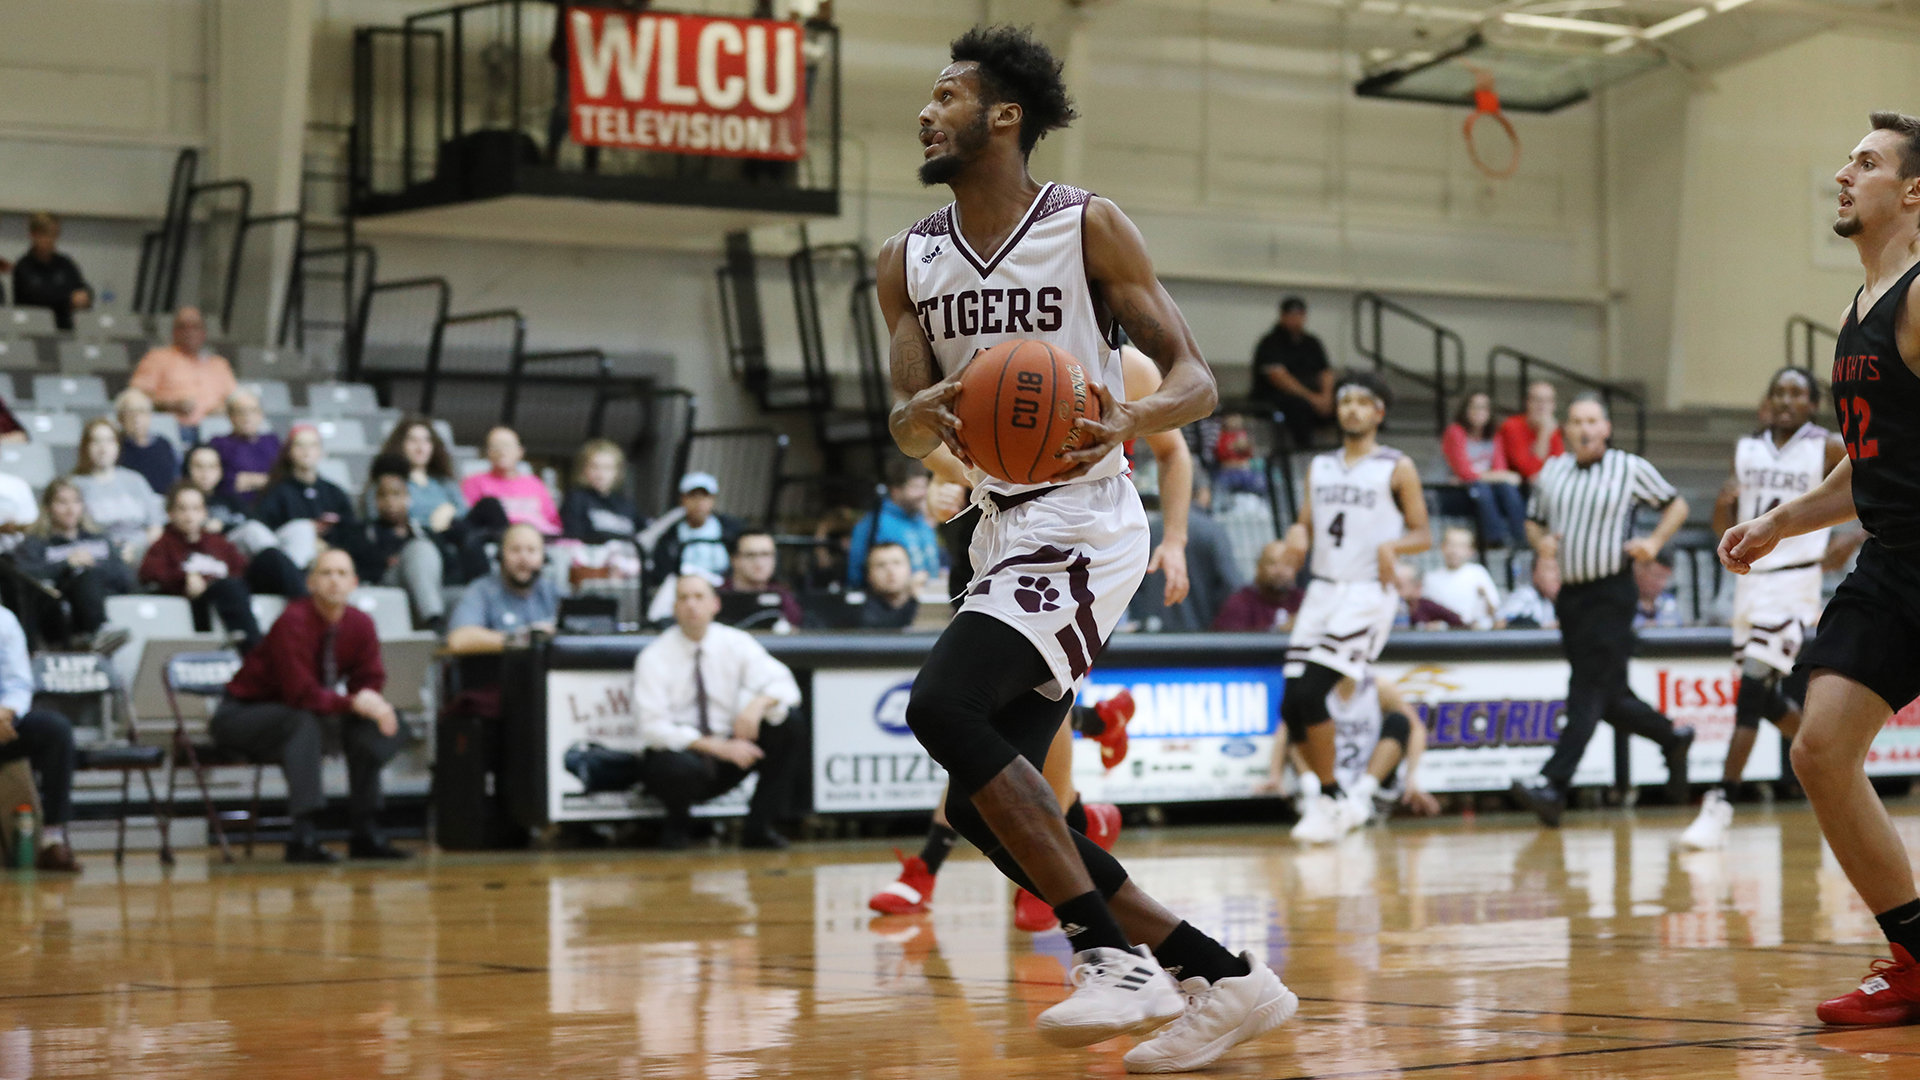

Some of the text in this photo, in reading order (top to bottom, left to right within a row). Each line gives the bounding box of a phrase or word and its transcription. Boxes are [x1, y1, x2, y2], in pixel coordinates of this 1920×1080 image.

[571, 10, 796, 113] WLCU
[575, 104, 771, 152] TELEVISION
[917, 286, 1062, 342] TIGERS
[1011, 371, 1043, 429] CU 18
[1328, 511, 1345, 548] 4
